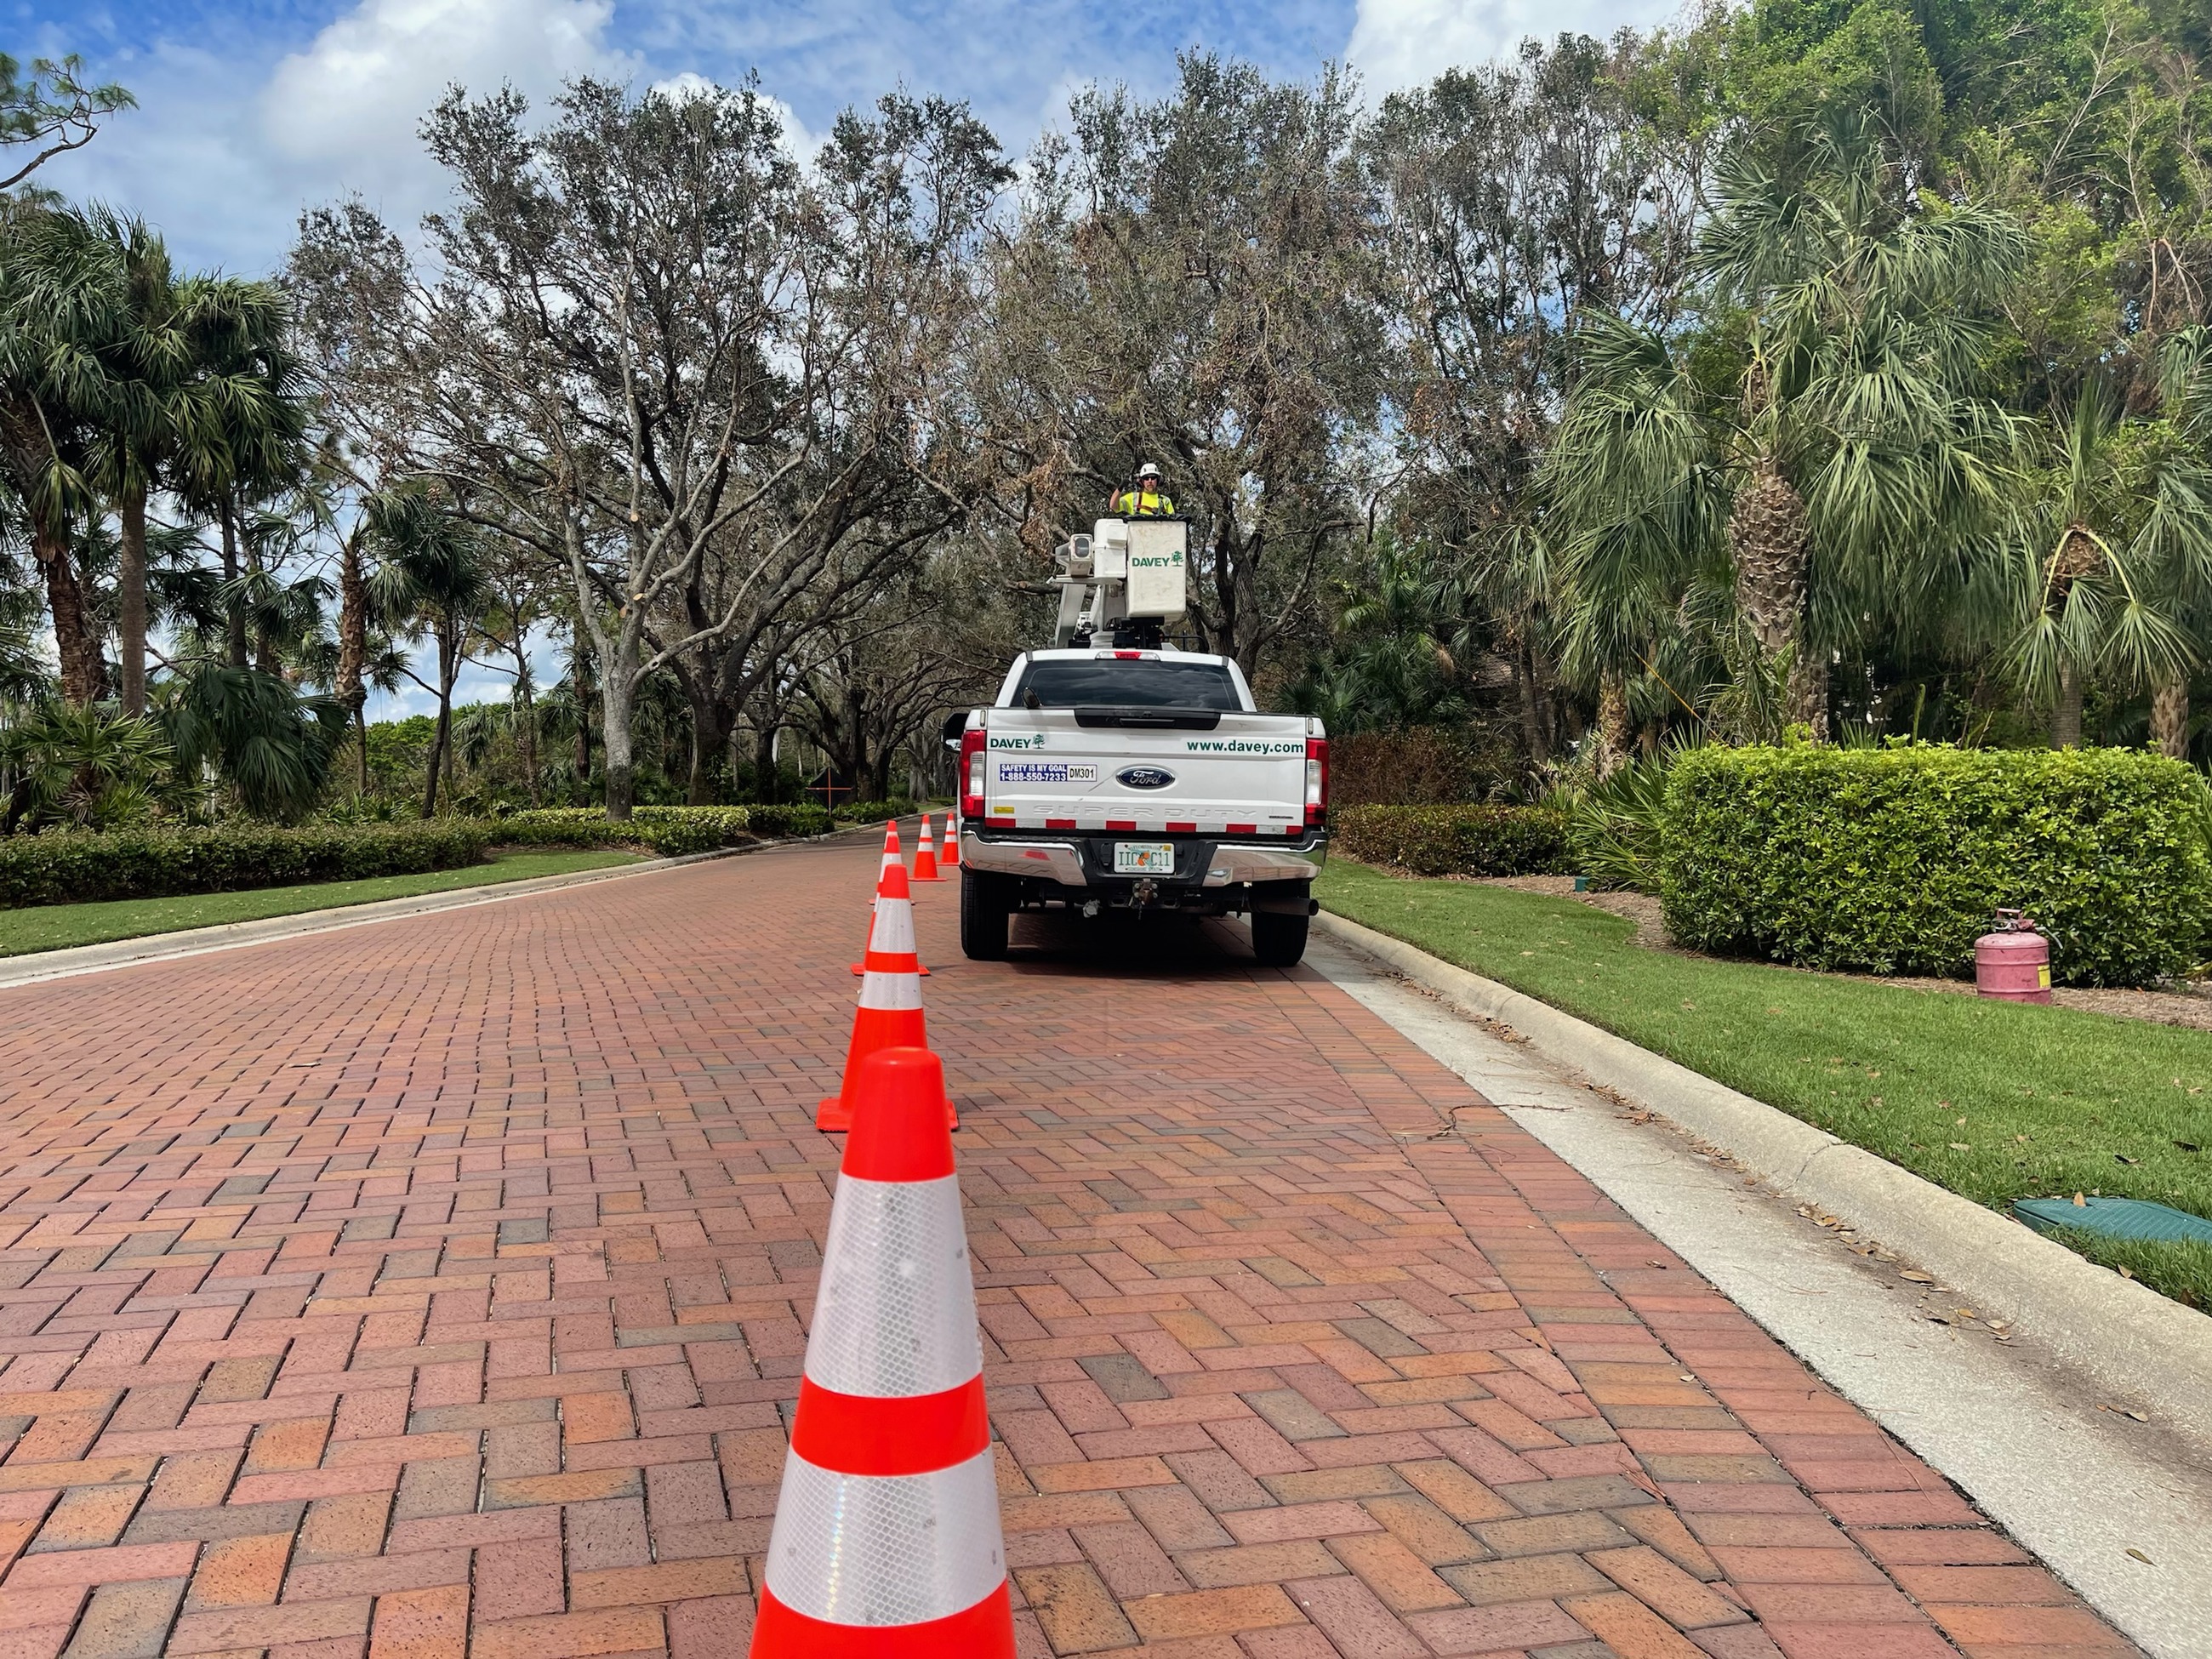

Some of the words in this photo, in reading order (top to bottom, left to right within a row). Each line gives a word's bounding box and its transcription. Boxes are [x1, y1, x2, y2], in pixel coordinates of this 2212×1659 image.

[1132, 557, 1170, 567] DAVEY
[990, 738, 1031, 748] DAVEY
[1187, 739, 1303, 755] www.davey.com
[1001, 772, 1066, 781] 1-888-550-7233
[1069, 768, 1094, 778] DM301
[1129, 770, 1161, 785] Ford
[1033, 805, 1154, 817] SUPER
[1164, 808, 1257, 819] DUTY
